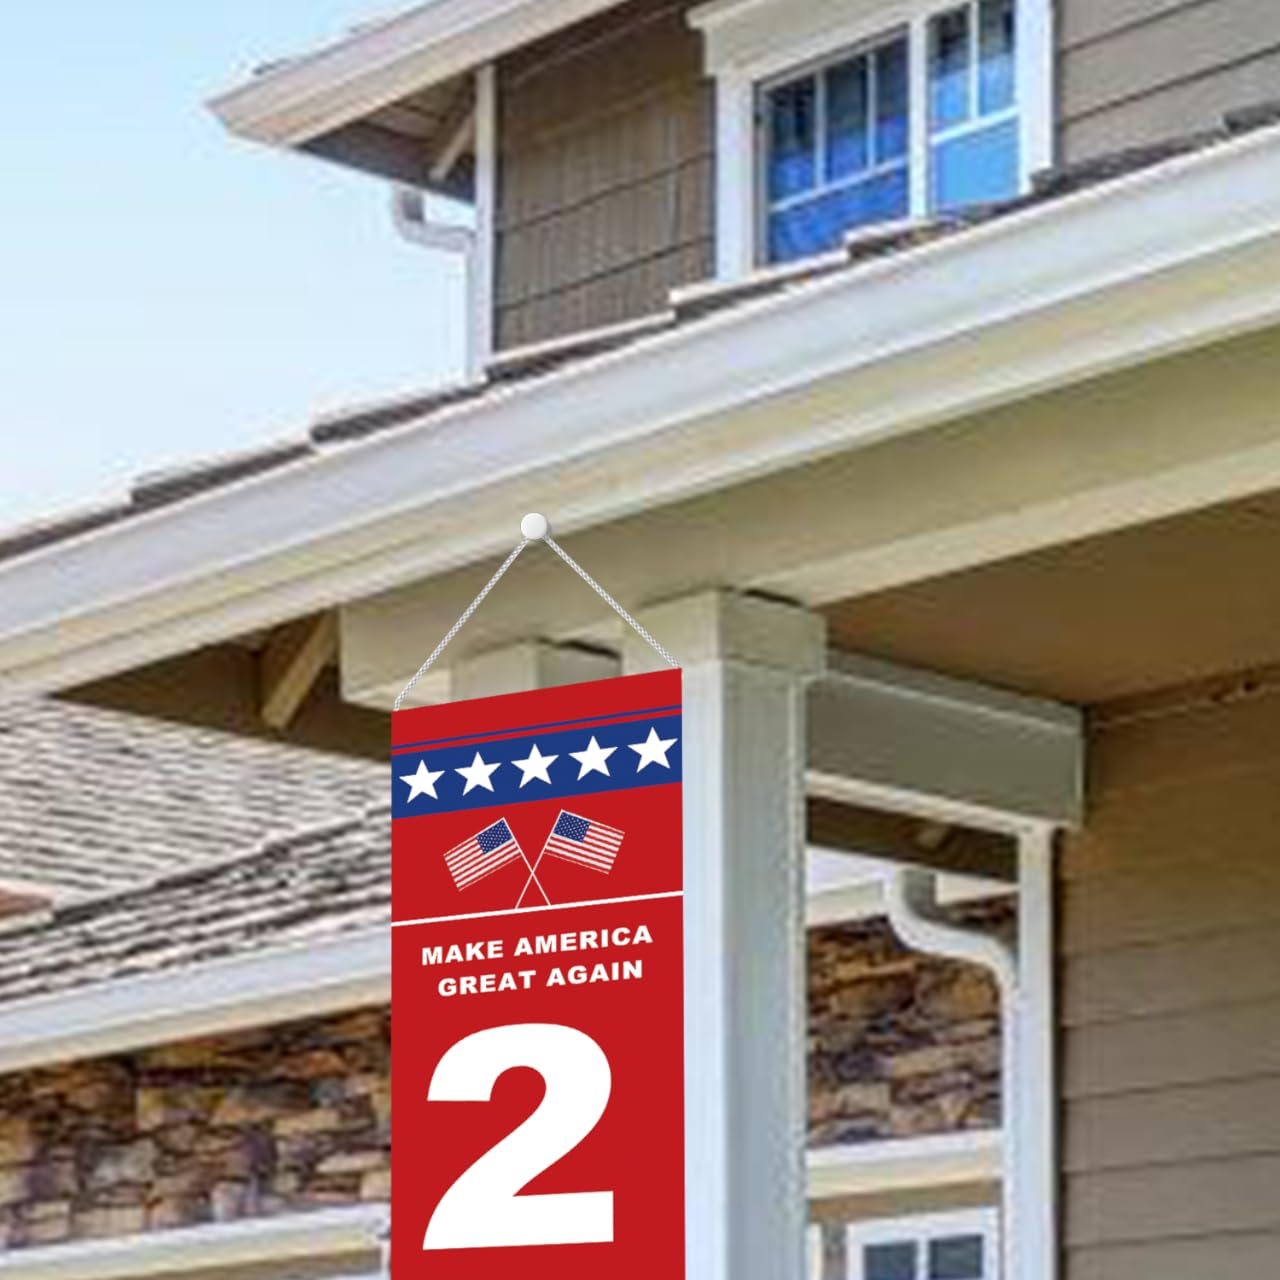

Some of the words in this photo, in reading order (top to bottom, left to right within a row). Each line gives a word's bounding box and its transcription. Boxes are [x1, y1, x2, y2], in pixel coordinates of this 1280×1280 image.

[422, 940, 504, 966] MAKE
[514, 925, 653, 957] AMERICA
[438, 970, 537, 997] GREAT
[546, 959, 642, 987] AGAIN
